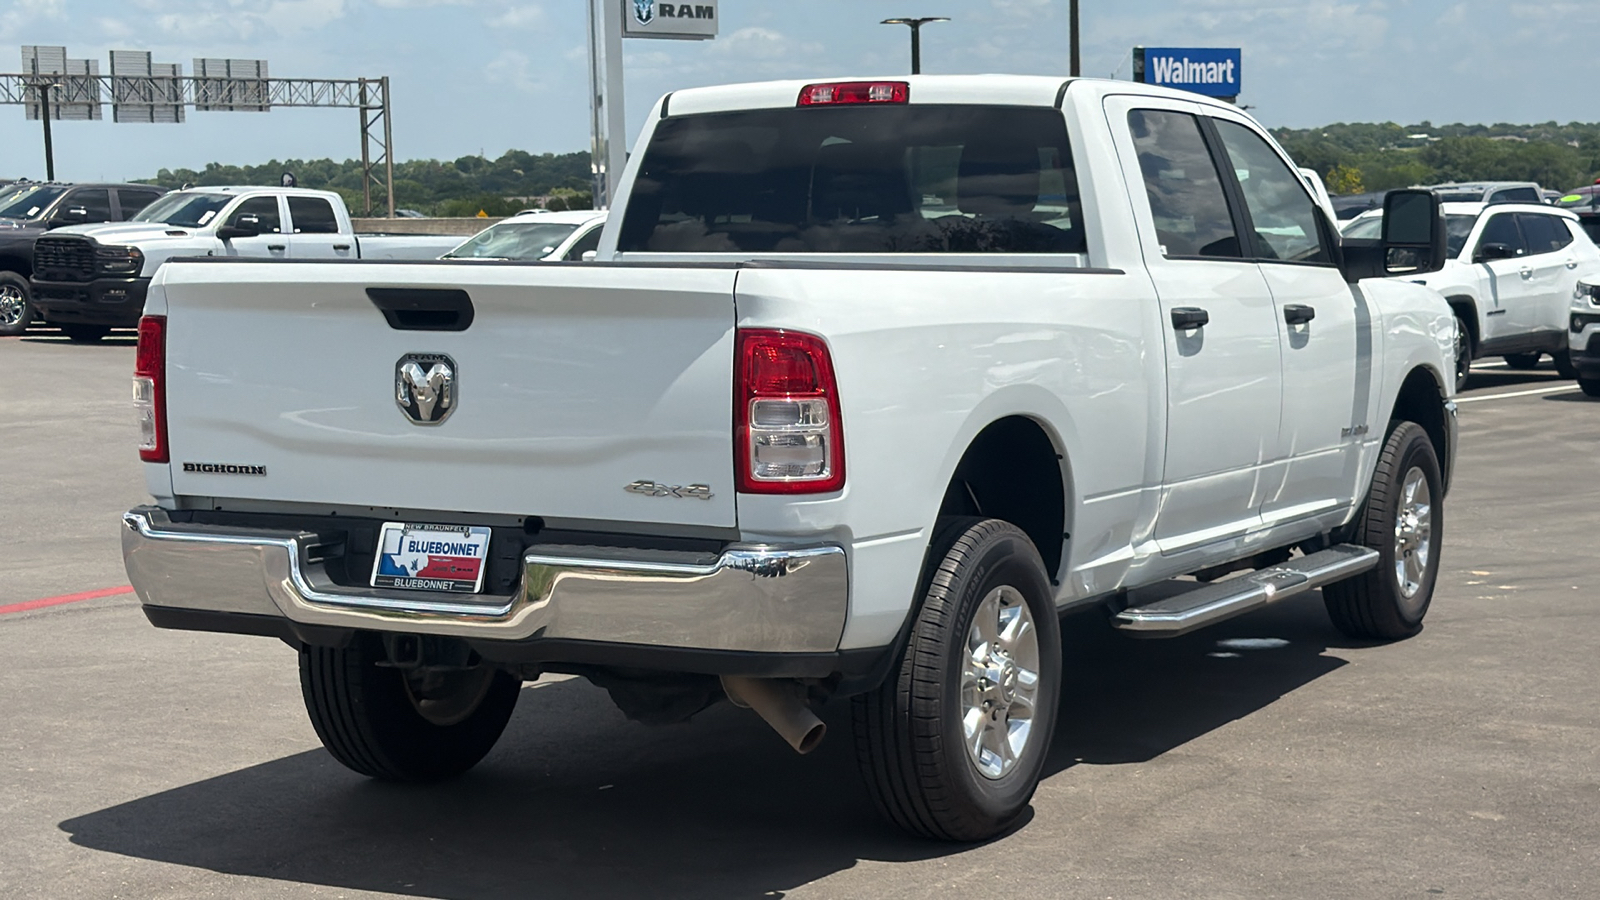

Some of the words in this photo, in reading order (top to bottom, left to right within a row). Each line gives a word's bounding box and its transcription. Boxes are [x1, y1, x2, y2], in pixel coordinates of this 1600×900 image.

[659, 4, 714, 19] RAM
[1153, 57, 1235, 84] Walmart
[408, 540, 480, 556] BLUEBONNET
[394, 578, 454, 590] BLUEBONNET
